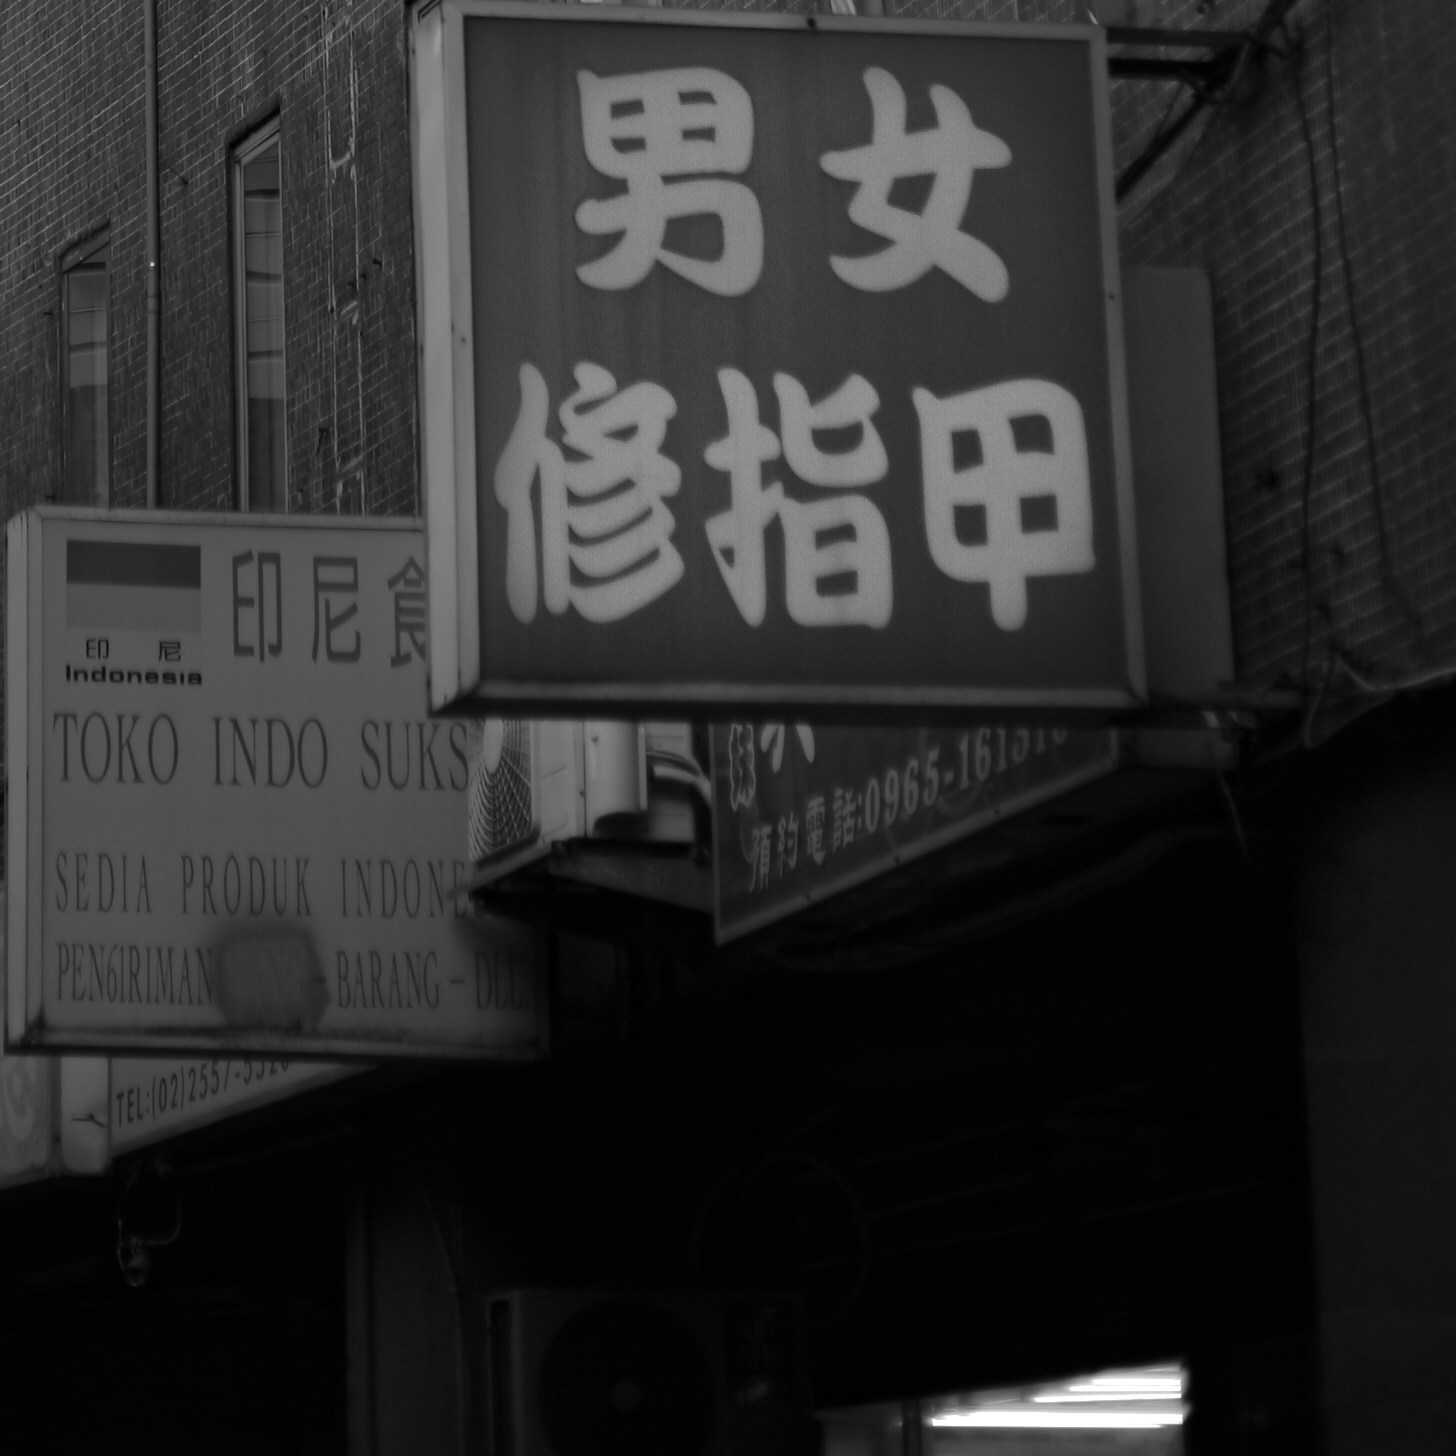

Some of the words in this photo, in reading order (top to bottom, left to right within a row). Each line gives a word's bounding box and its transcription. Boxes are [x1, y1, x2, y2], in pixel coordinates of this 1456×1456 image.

[574, 66, 1014, 304] 男女
[493, 360, 1097, 633] 修指甲
[65, 664, 203, 686] Indonesia
[85, 638, 182, 663] 印尼
[52, 710, 180, 786] TOKO
[213, 716, 329, 789] INDO
[55, 852, 152, 915] SEDIA
[181, 855, 313, 919] PRODUK
[336, 950, 441, 1010] BARANG
